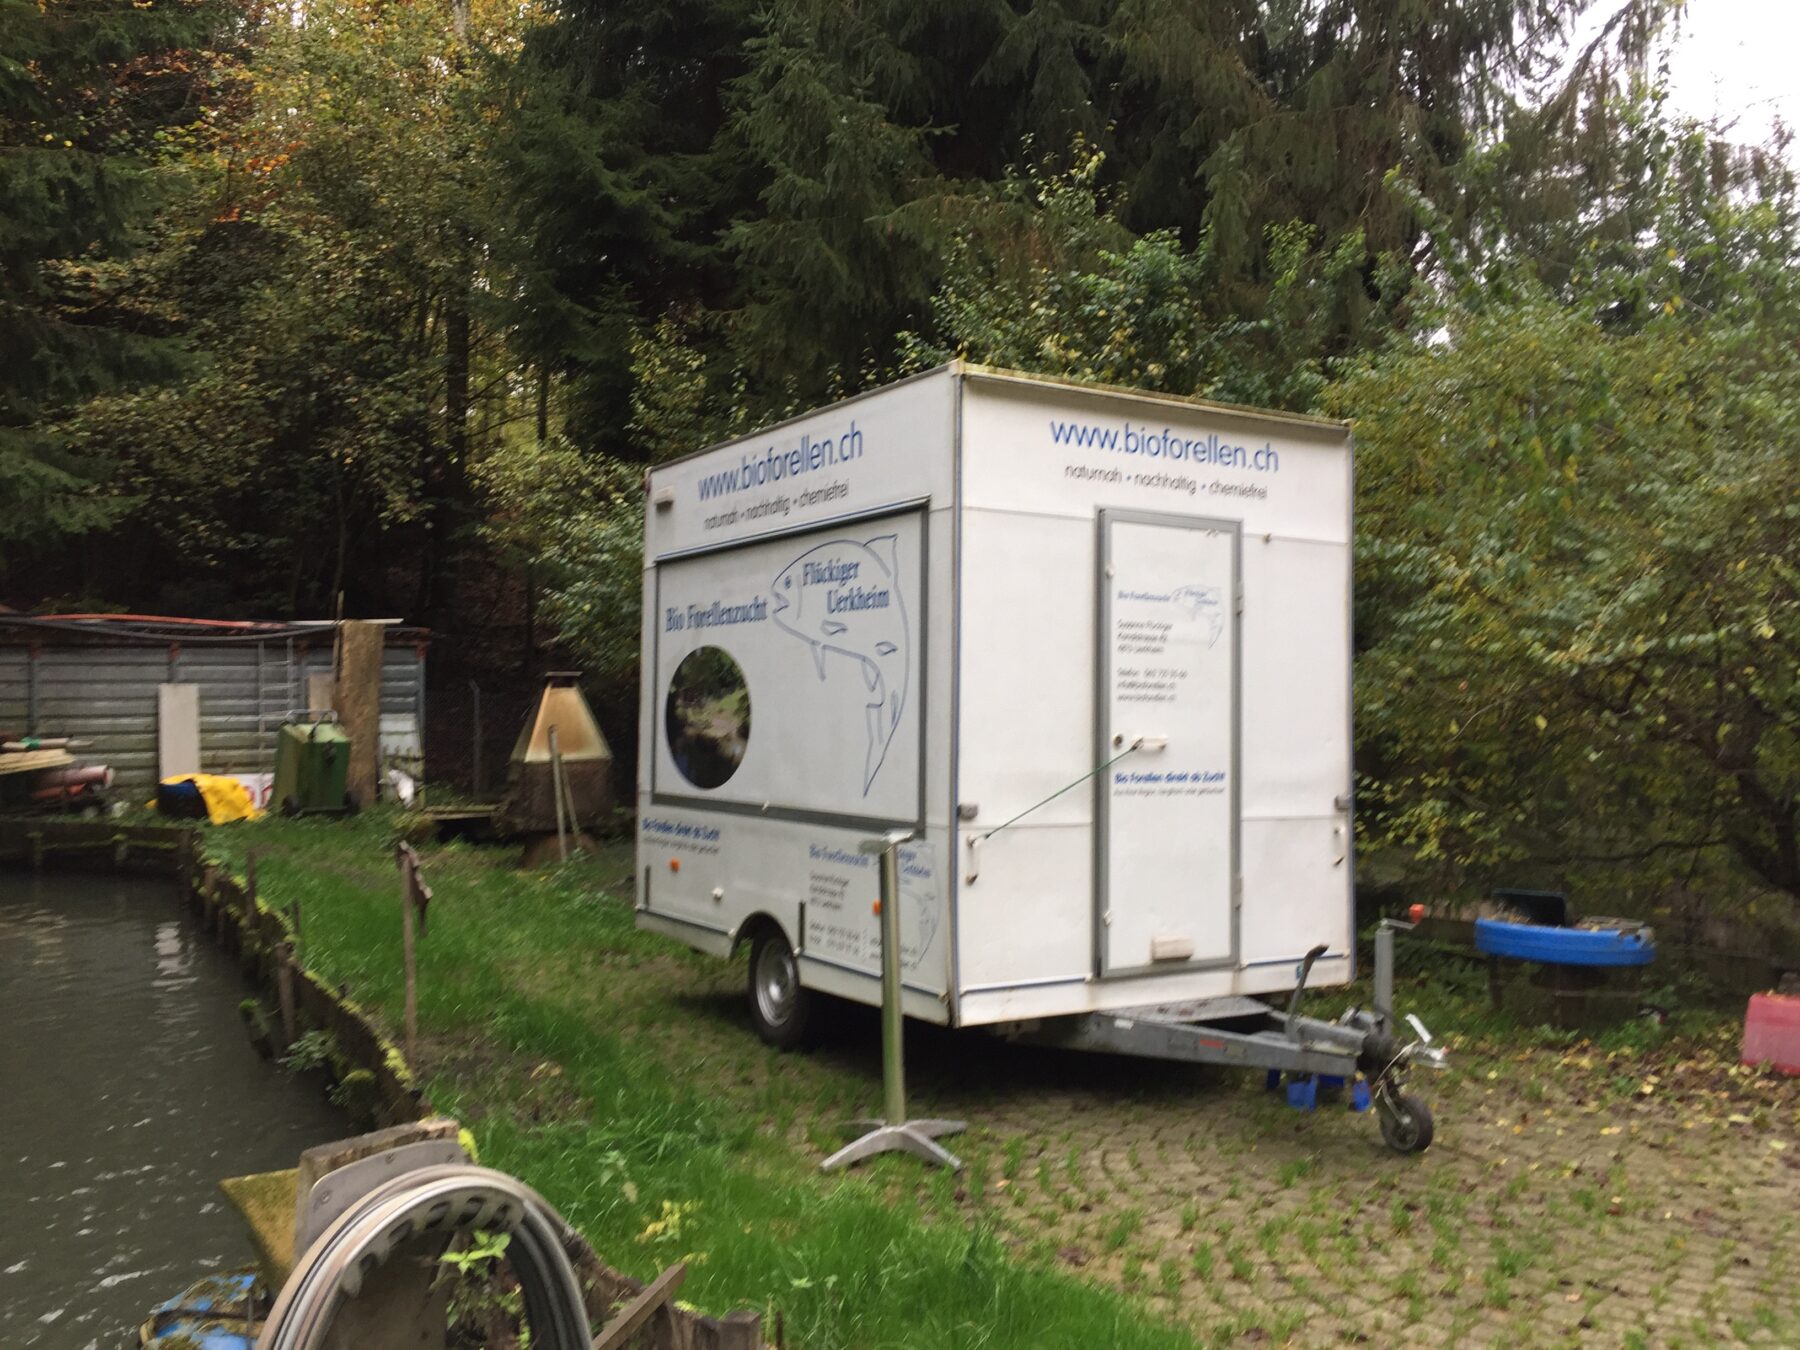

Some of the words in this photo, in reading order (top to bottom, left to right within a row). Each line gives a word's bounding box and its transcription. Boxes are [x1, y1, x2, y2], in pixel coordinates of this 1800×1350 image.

[698, 420, 863, 500] www.bioforellen.ch
[1051, 421, 1279, 473] www.bioforellen.ch
[1064, 464, 1122, 483] naturnah
[1134, 472, 1197, 495] nachhaltig
[1209, 480, 1268, 499] chemiefrei
[665, 606, 685, 632] Bio
